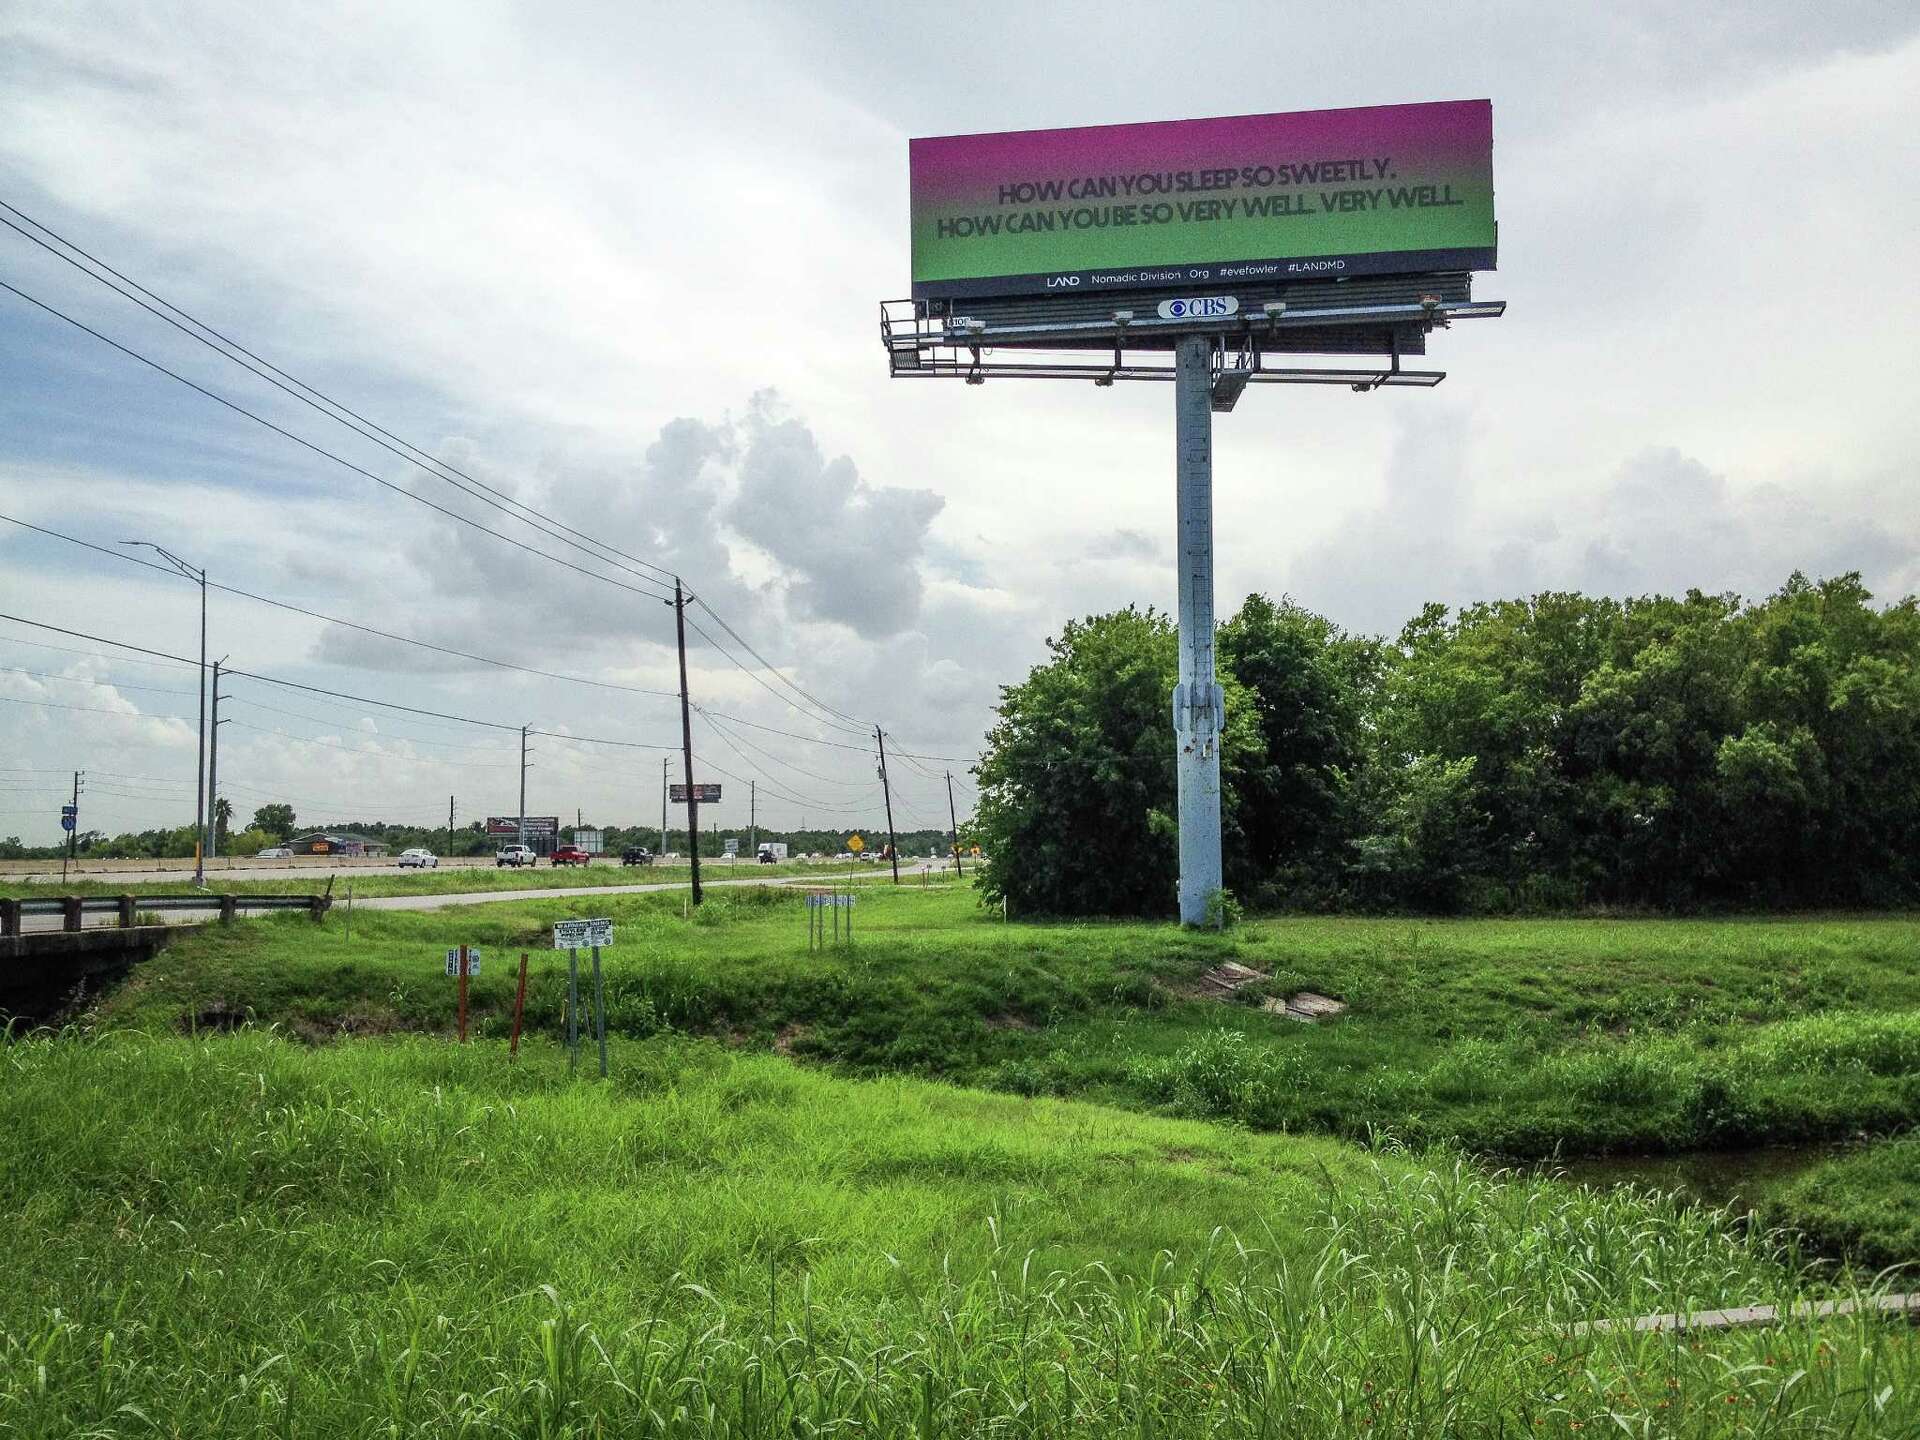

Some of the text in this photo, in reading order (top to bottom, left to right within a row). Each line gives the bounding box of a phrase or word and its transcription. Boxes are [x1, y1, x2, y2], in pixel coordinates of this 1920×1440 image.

[999, 157, 1397, 205] HOW CAN YOU SLEEP SO SWEETLY.
[937, 214, 1003, 239] HOW
[1004, 210, 1055, 234] CAN
[1053, 206, 1111, 231] YOU
[1112, 204, 1137, 226] BE
[1139, 203, 1174, 224] SO
[1176, 198, 1241, 222] VERY
[1318, 189, 1385, 213] VERY
[1047, 260, 1346, 287] LAND Nomadic Division Org #evefowler #LANDMD
[1189, 297, 1228, 317] CBS
